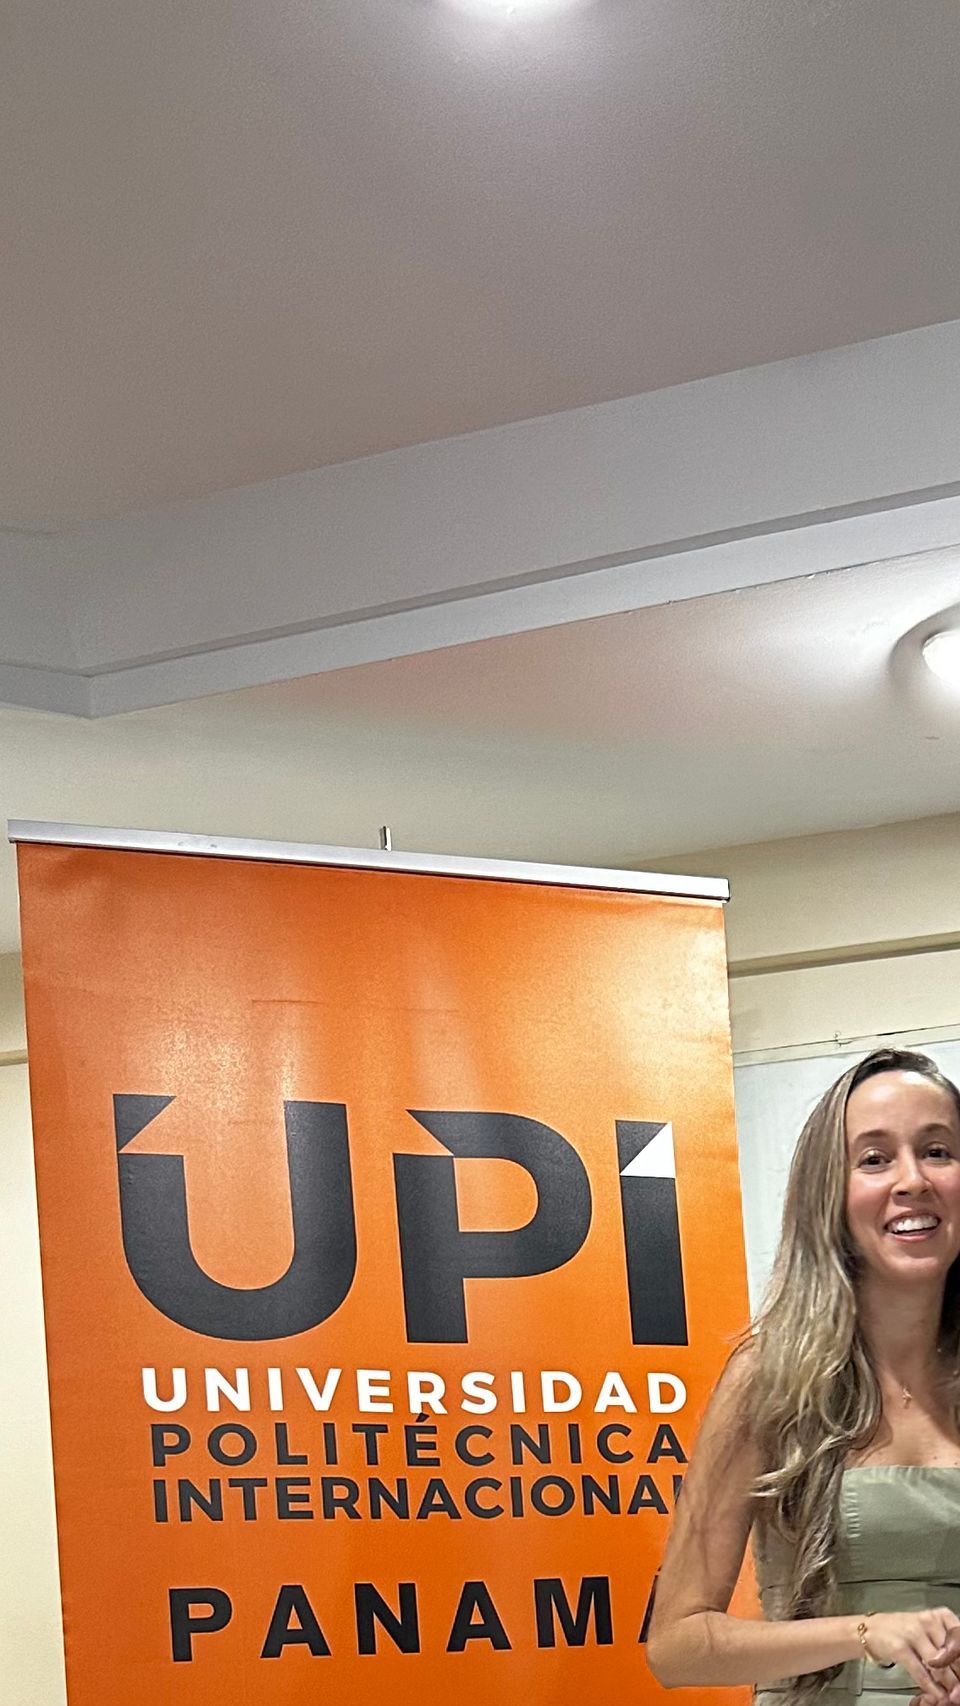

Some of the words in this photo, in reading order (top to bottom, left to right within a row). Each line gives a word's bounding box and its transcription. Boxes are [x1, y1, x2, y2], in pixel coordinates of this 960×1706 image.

[142, 1368, 687, 1414] UNIVERSIDAD
[150, 1412, 689, 1467] POLITÉCNICA
[168, 1566, 661, 1662] PANAM
